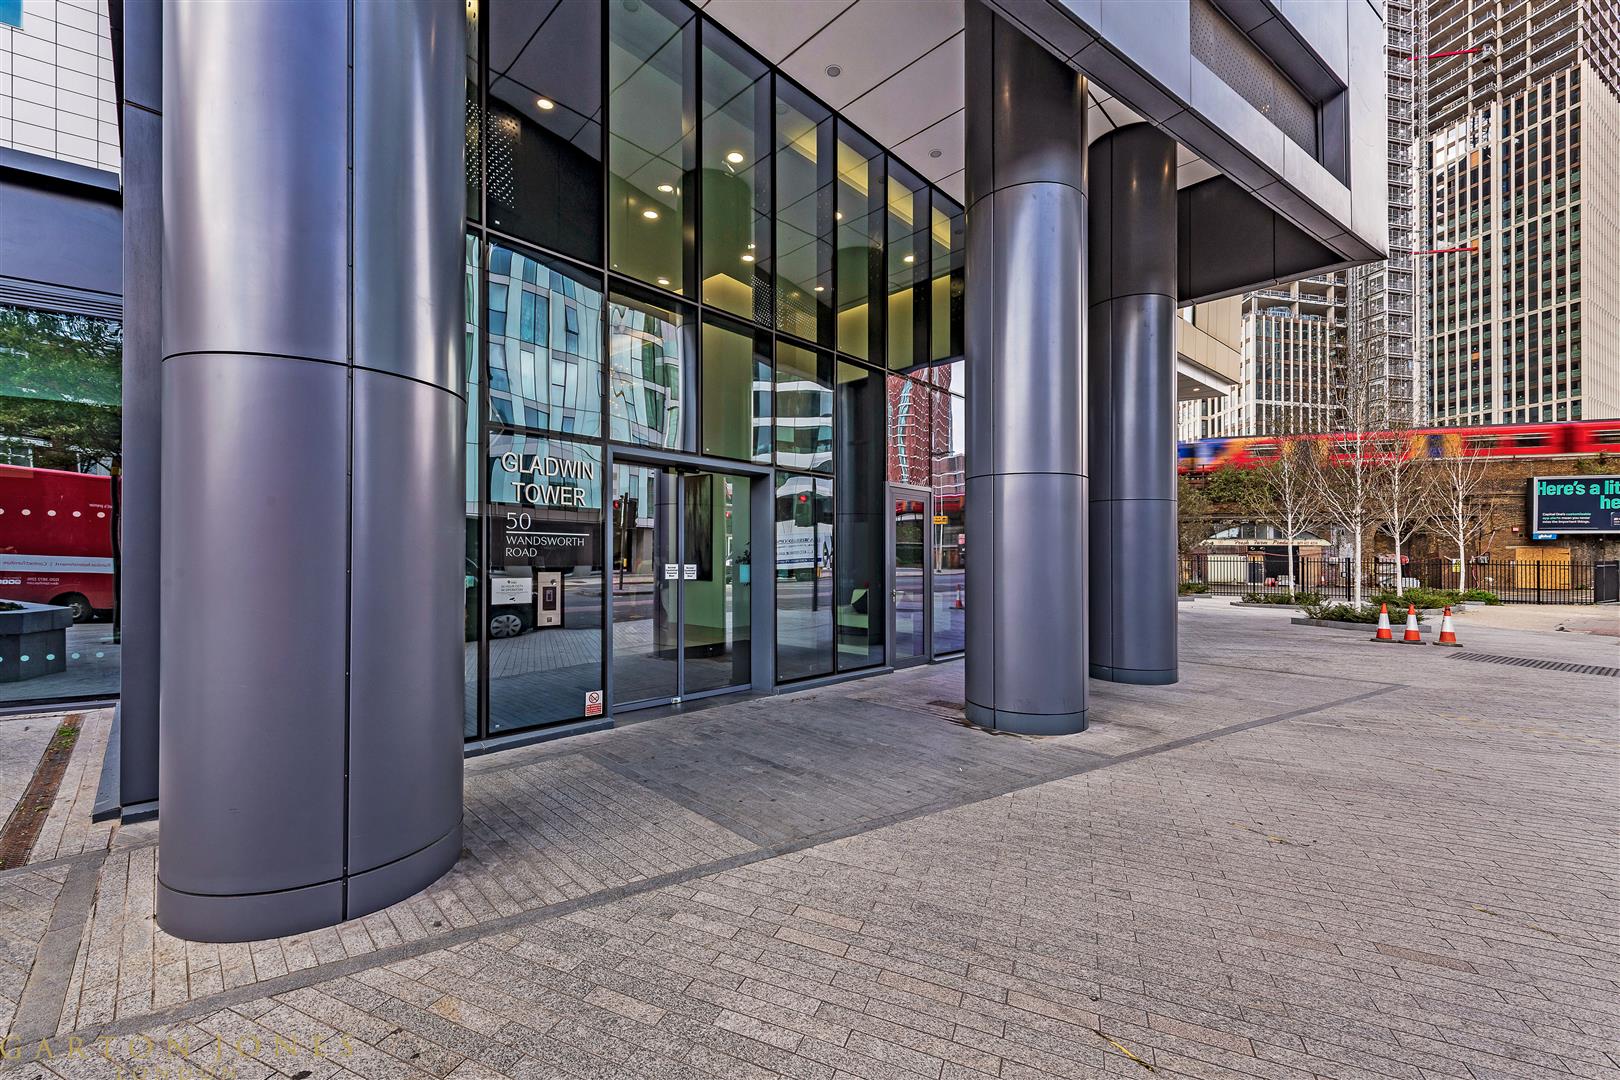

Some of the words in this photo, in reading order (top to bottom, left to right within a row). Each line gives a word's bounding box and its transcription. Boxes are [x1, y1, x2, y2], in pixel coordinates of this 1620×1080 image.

[501, 452, 594, 480] GLADWIN
[511, 482, 586, 507] TOWER
[1537, 481, 1586, 495] Here's
[1589, 483, 1600, 495] a
[506, 512, 531, 530] 50
[506, 536, 585, 547] WANDSWORTH
[505, 548, 538, 558] ROAD
